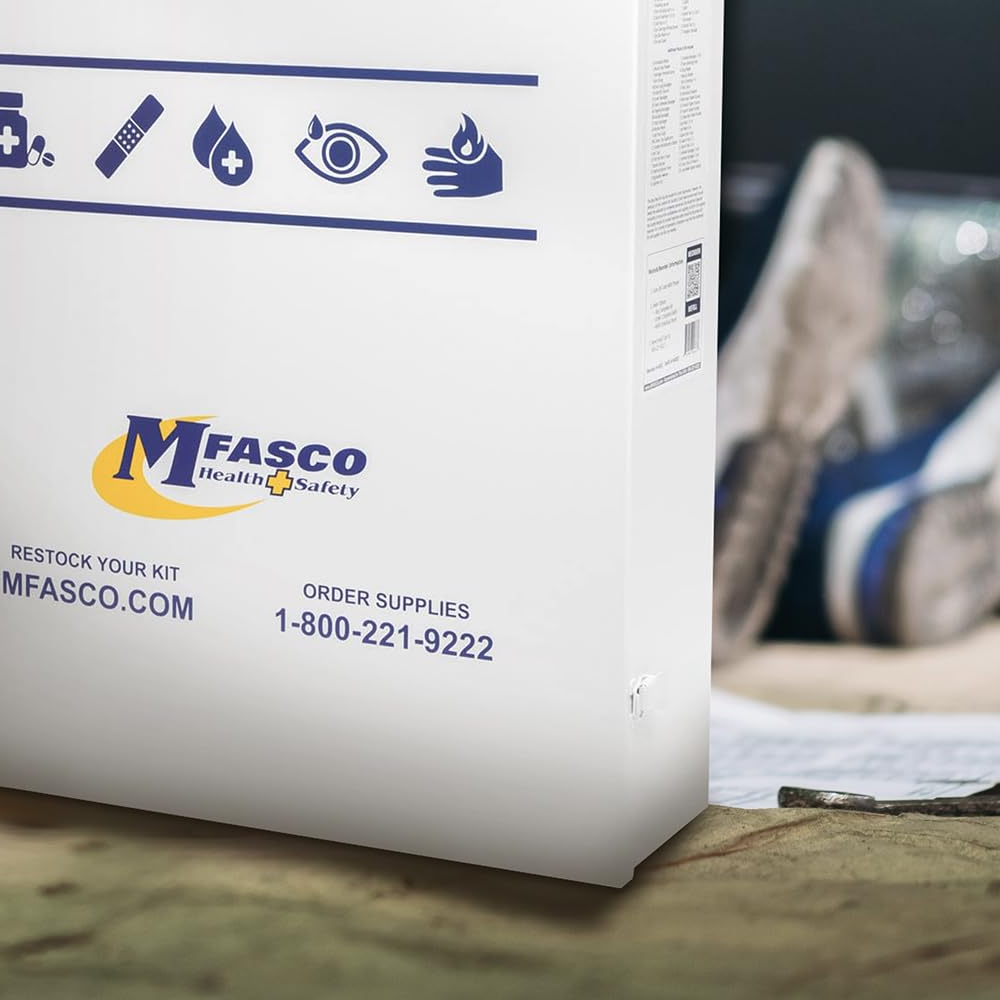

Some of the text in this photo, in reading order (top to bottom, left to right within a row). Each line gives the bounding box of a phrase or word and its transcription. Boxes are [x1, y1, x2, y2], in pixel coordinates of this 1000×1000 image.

[112, 415, 367, 488] MFASCO
[199, 466, 361, 500] Health Safety
[10, 544, 181, 582] RESTOCK YOUR KIT
[1, 569, 194, 621] MFASCO.COM
[302, 583, 470, 620] ORDER SUPPLIES
[274, 606, 494, 662] 1-800-221-9222
